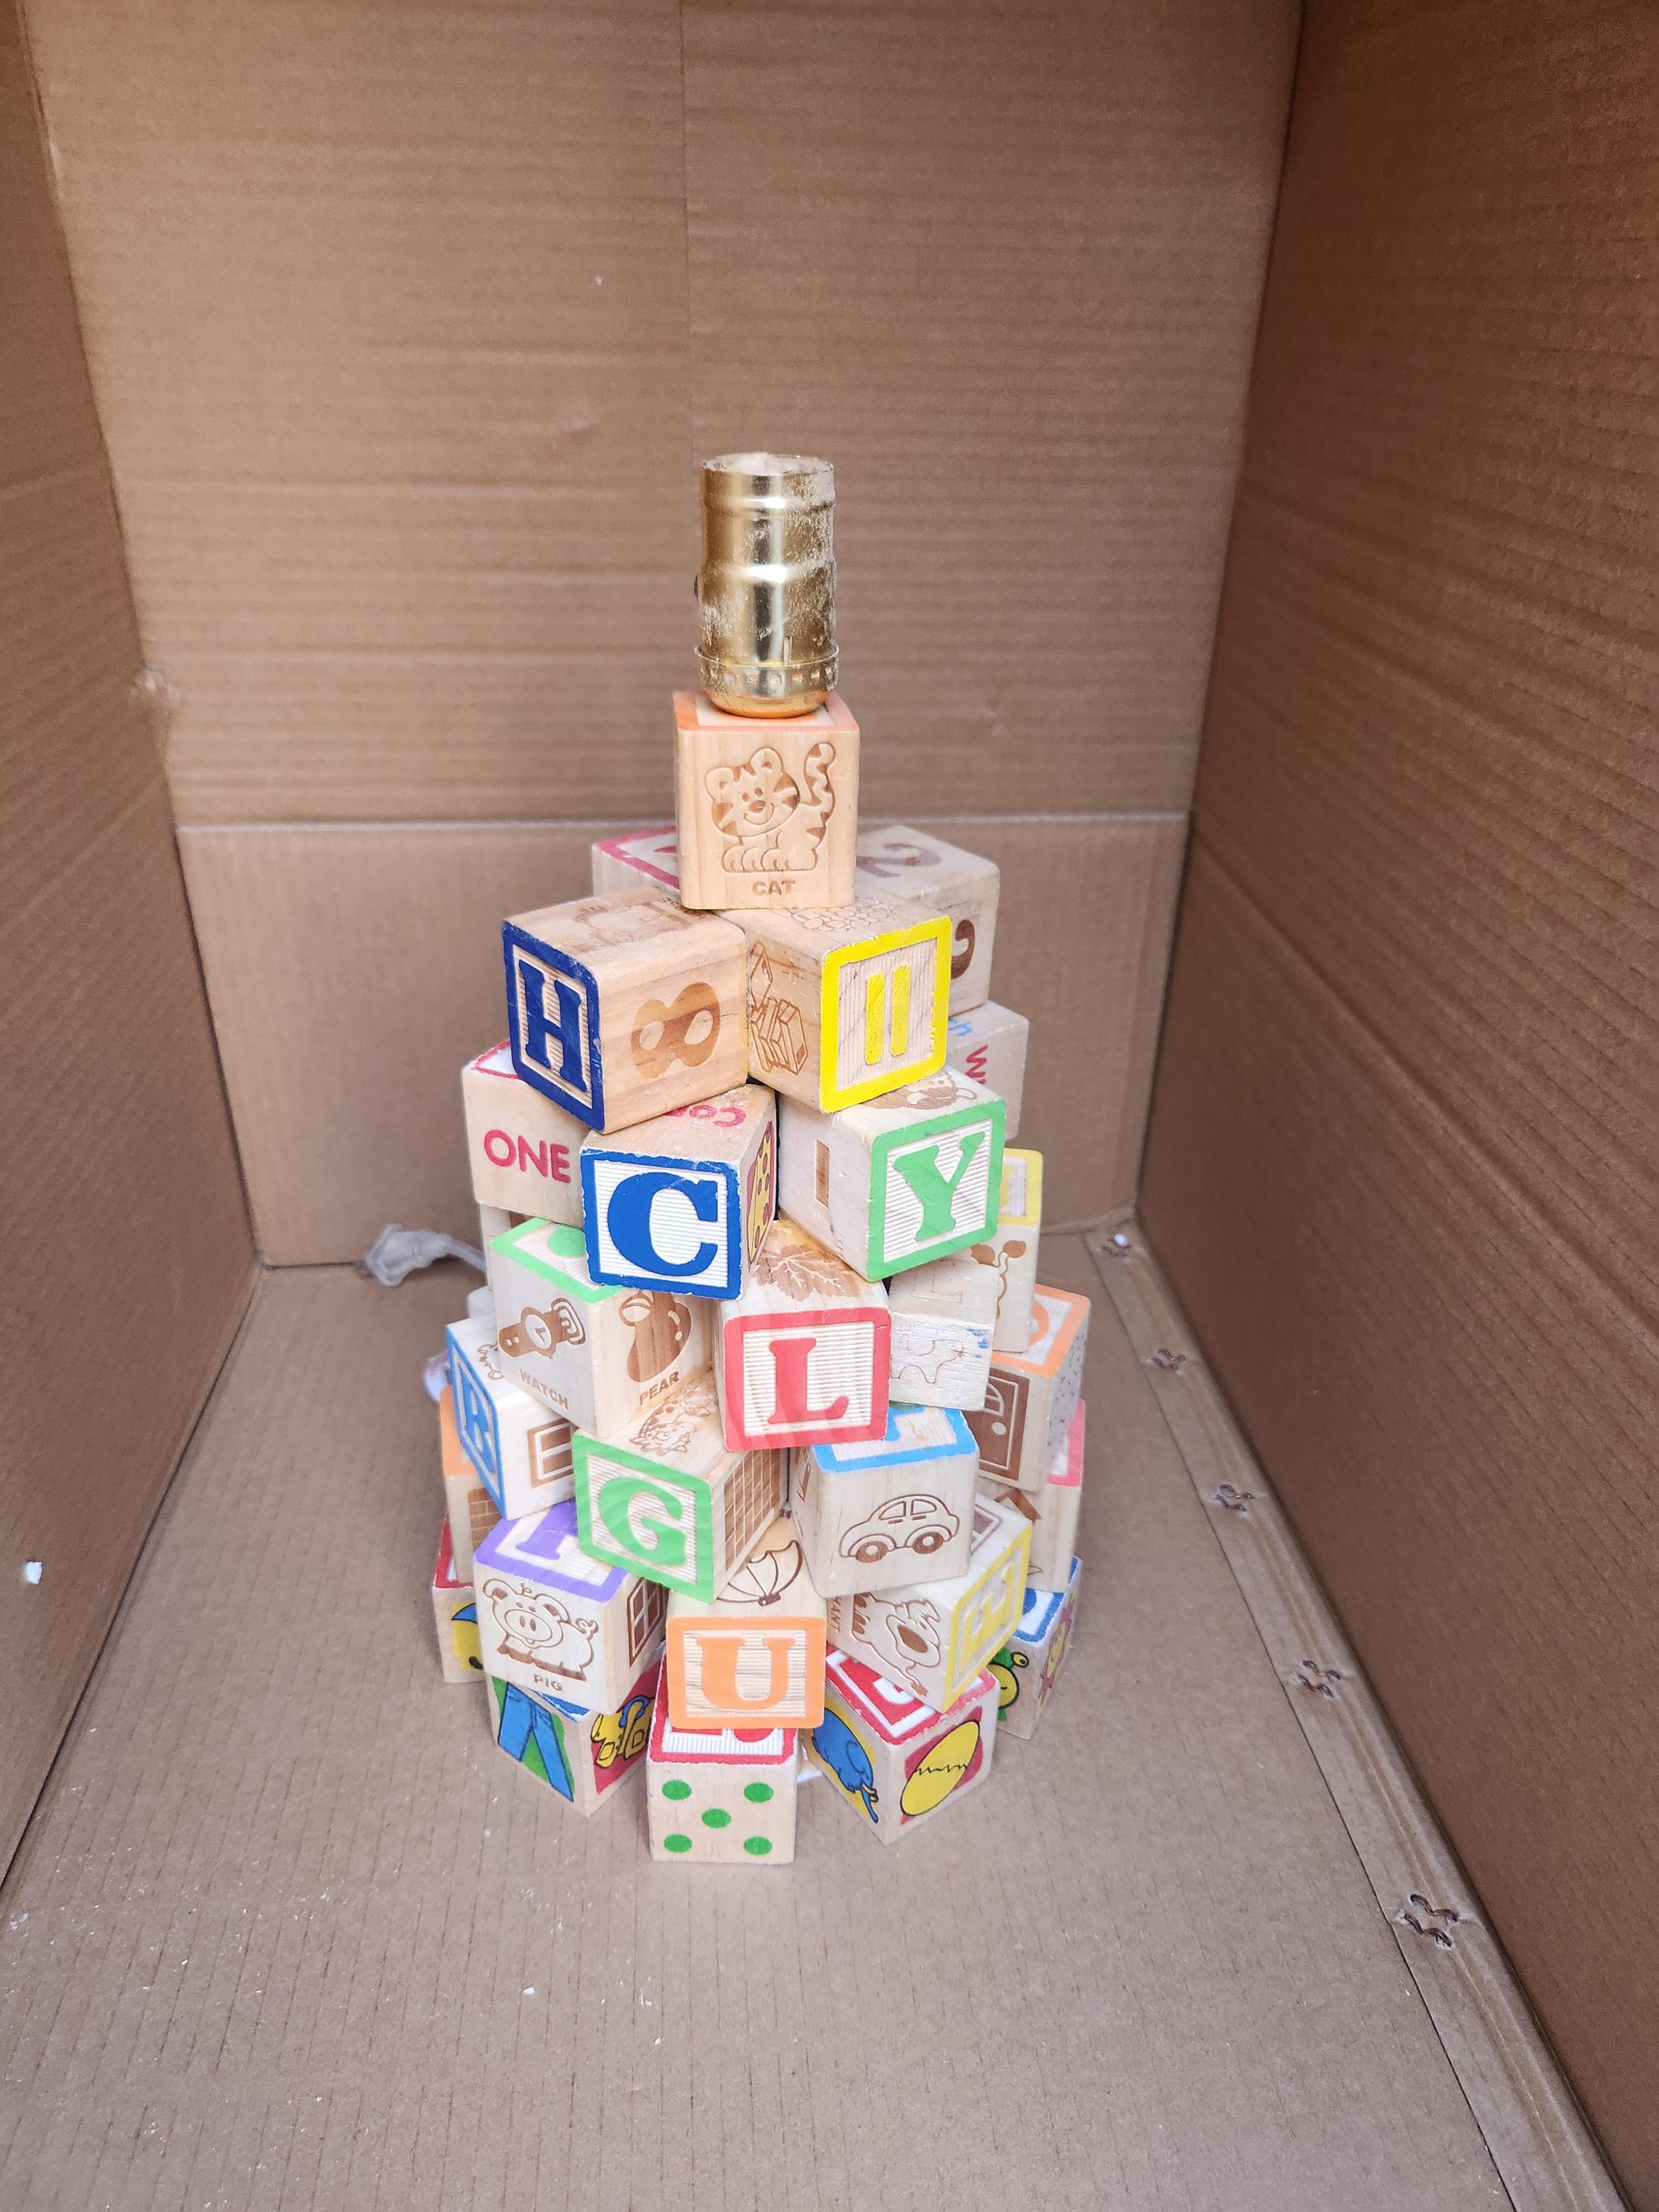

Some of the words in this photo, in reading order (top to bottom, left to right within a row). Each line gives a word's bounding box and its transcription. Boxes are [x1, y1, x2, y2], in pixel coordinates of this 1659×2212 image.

[752, 880, 796, 898] CAT
[518, 959, 588, 1093] H
[484, 1129, 572, 1183] ONE
[893, 1130, 986, 1242] Y
[607, 1171, 719, 1277] C
[519, 1368, 569, 1411] WATCH
[639, 1370, 681, 1407] PEAR
[768, 1337, 850, 1425] L
[597, 1476, 687, 1567] G
[533, 1674, 563, 1692] PIG
[696, 1637, 796, 1710] U
